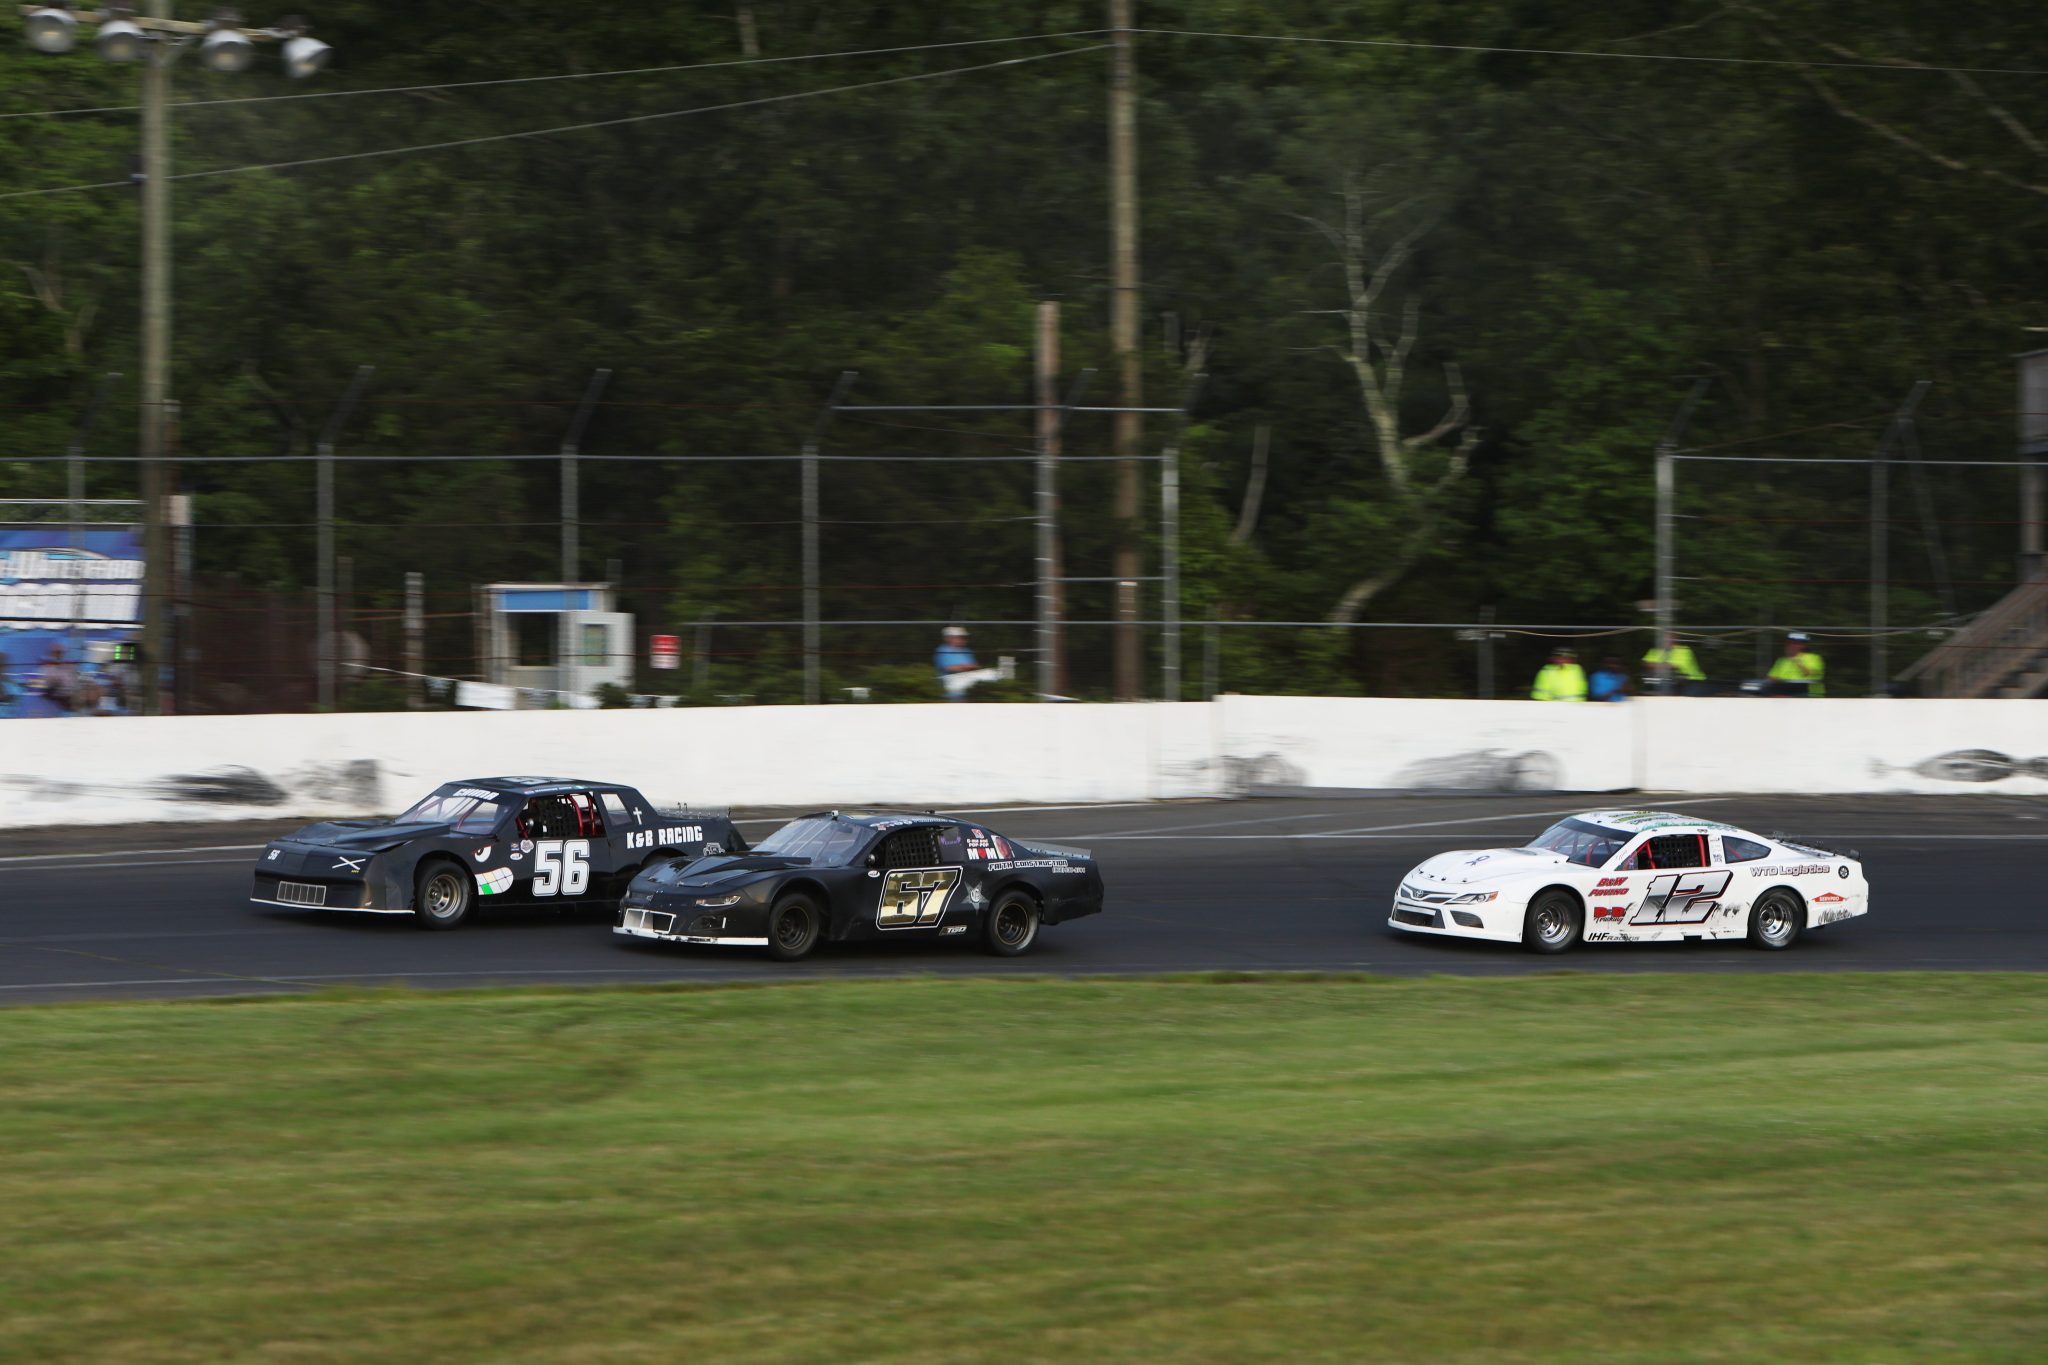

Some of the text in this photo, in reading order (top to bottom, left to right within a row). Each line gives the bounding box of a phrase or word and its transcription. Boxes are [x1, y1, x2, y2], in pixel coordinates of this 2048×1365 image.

[626, 825, 703, 849] K&B RACING
[532, 839, 590, 896] 56
[988, 859, 1068, 872] FAITH CONSTRUCTION
[1750, 864, 1830, 877] WTD Logistics
[876, 865, 964, 931] 67
[1629, 869, 1734, 927] 12
